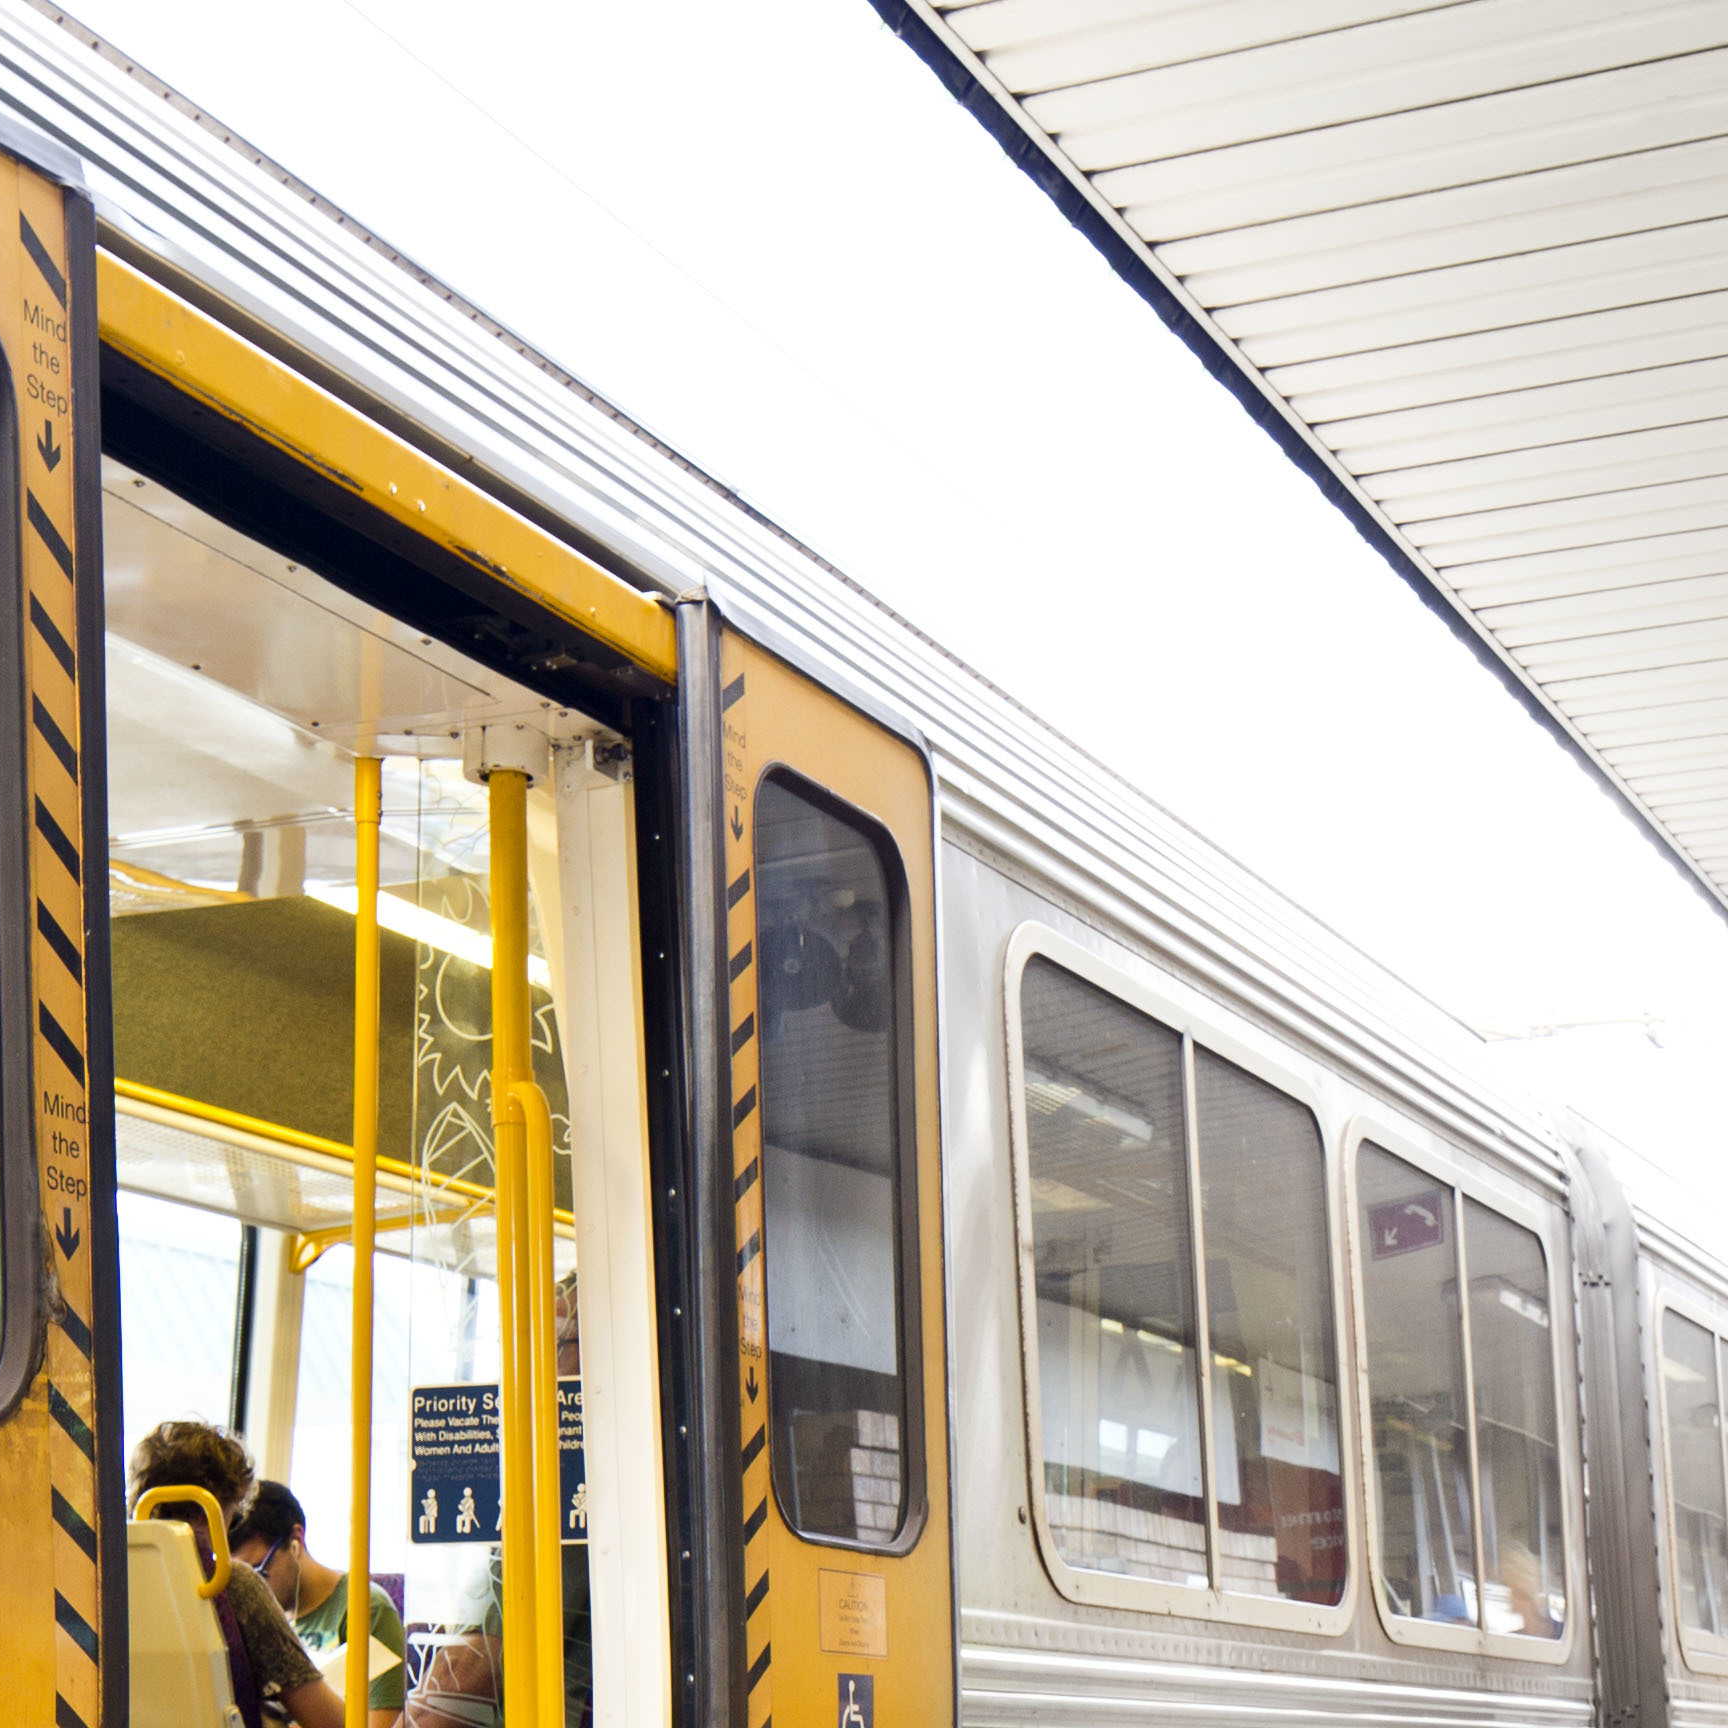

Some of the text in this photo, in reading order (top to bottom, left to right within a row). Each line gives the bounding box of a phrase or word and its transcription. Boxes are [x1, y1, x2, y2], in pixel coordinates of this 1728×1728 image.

[24, 298, 67, 342] Mind
[32, 341, 60, 374] the
[27, 374, 67, 416] Step
[725, 774, 747, 801] Step
[44, 1091, 86, 1124] Mind
[52, 1131, 80, 1159] the
[47, 1166, 87, 1201] Step
[740, 1337, 762, 1361] Step
[414, 1394, 476, 1415] Priority
[414, 1417, 446, 1428] Please
[447, 1416, 480, 1427] Vacate
[414, 1430, 437, 1442] With
[438, 1429, 494, 1442] Disabilities,
[414, 1444, 451, 1456] Women
[452, 1443, 472, 1454] And
